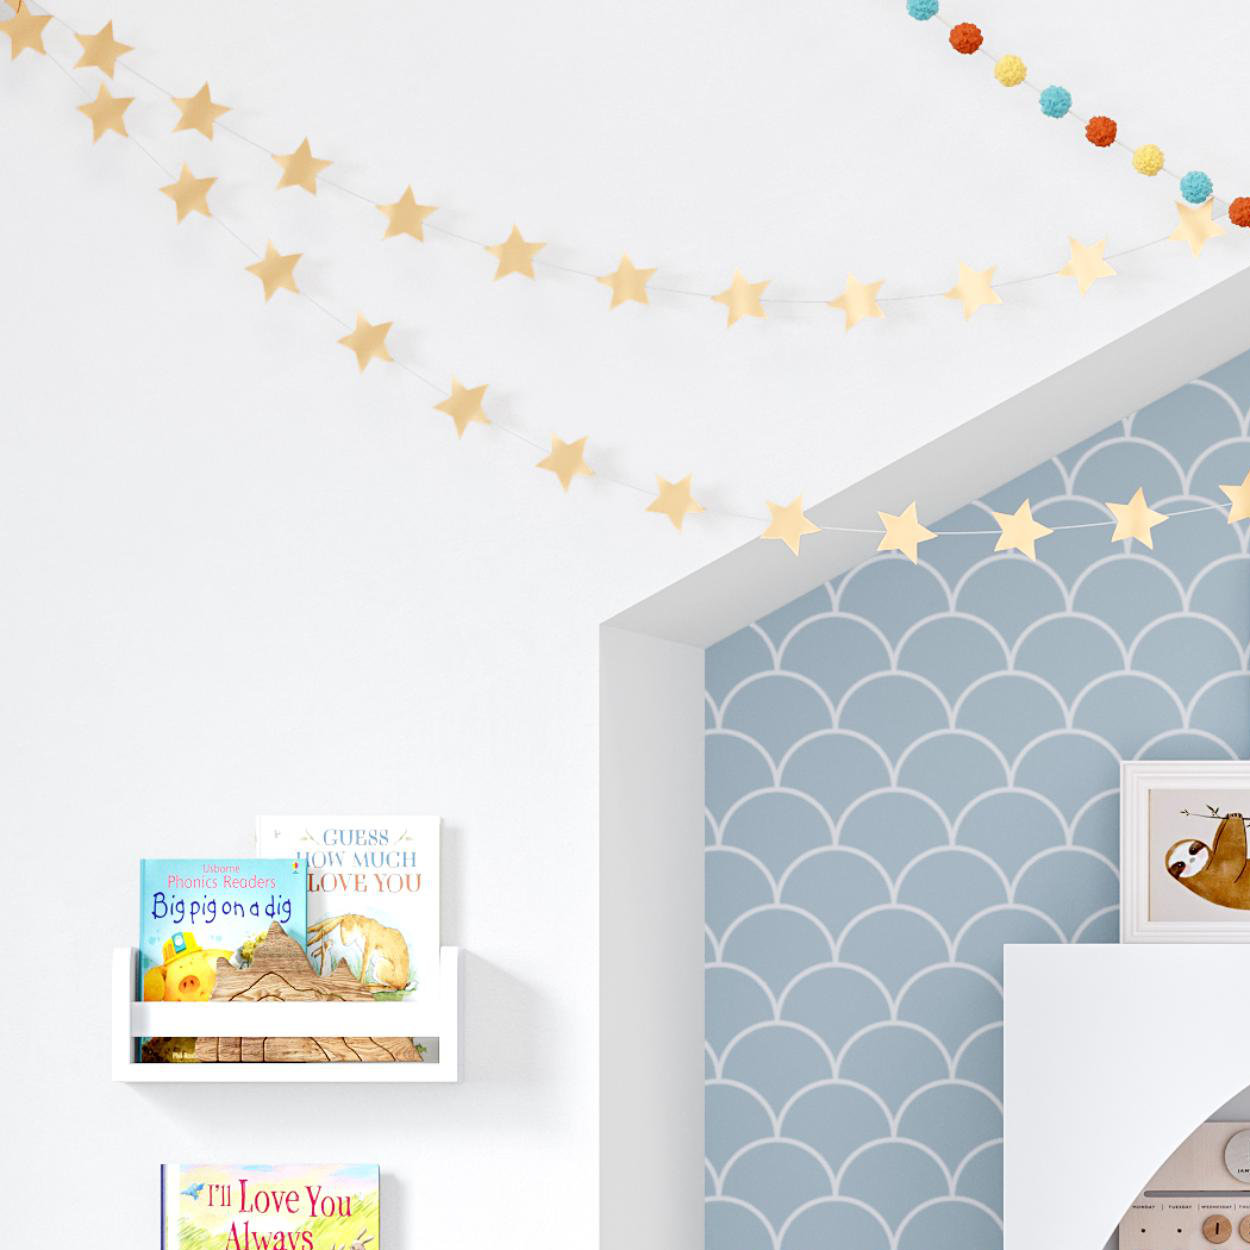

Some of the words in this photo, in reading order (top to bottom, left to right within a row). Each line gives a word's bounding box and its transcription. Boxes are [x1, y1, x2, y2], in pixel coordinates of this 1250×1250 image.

[323, 829, 389, 846] GUESS
[354, 851, 417, 868] MUCH
[202, 863, 240, 874] Usborne
[167, 875, 218, 889] Phonics
[223, 875, 276, 889] Readers
[307, 873, 368, 893] LOVE
[374, 873, 421, 893] YOU
[151, 891, 185, 924] Big
[190, 894, 217, 925] pig
[222, 900, 245, 918] on
[249, 901, 259, 917] a
[264, 895, 292, 924] dig
[238, 1179, 300, 1213] Love
[304, 1185, 352, 1218] You
